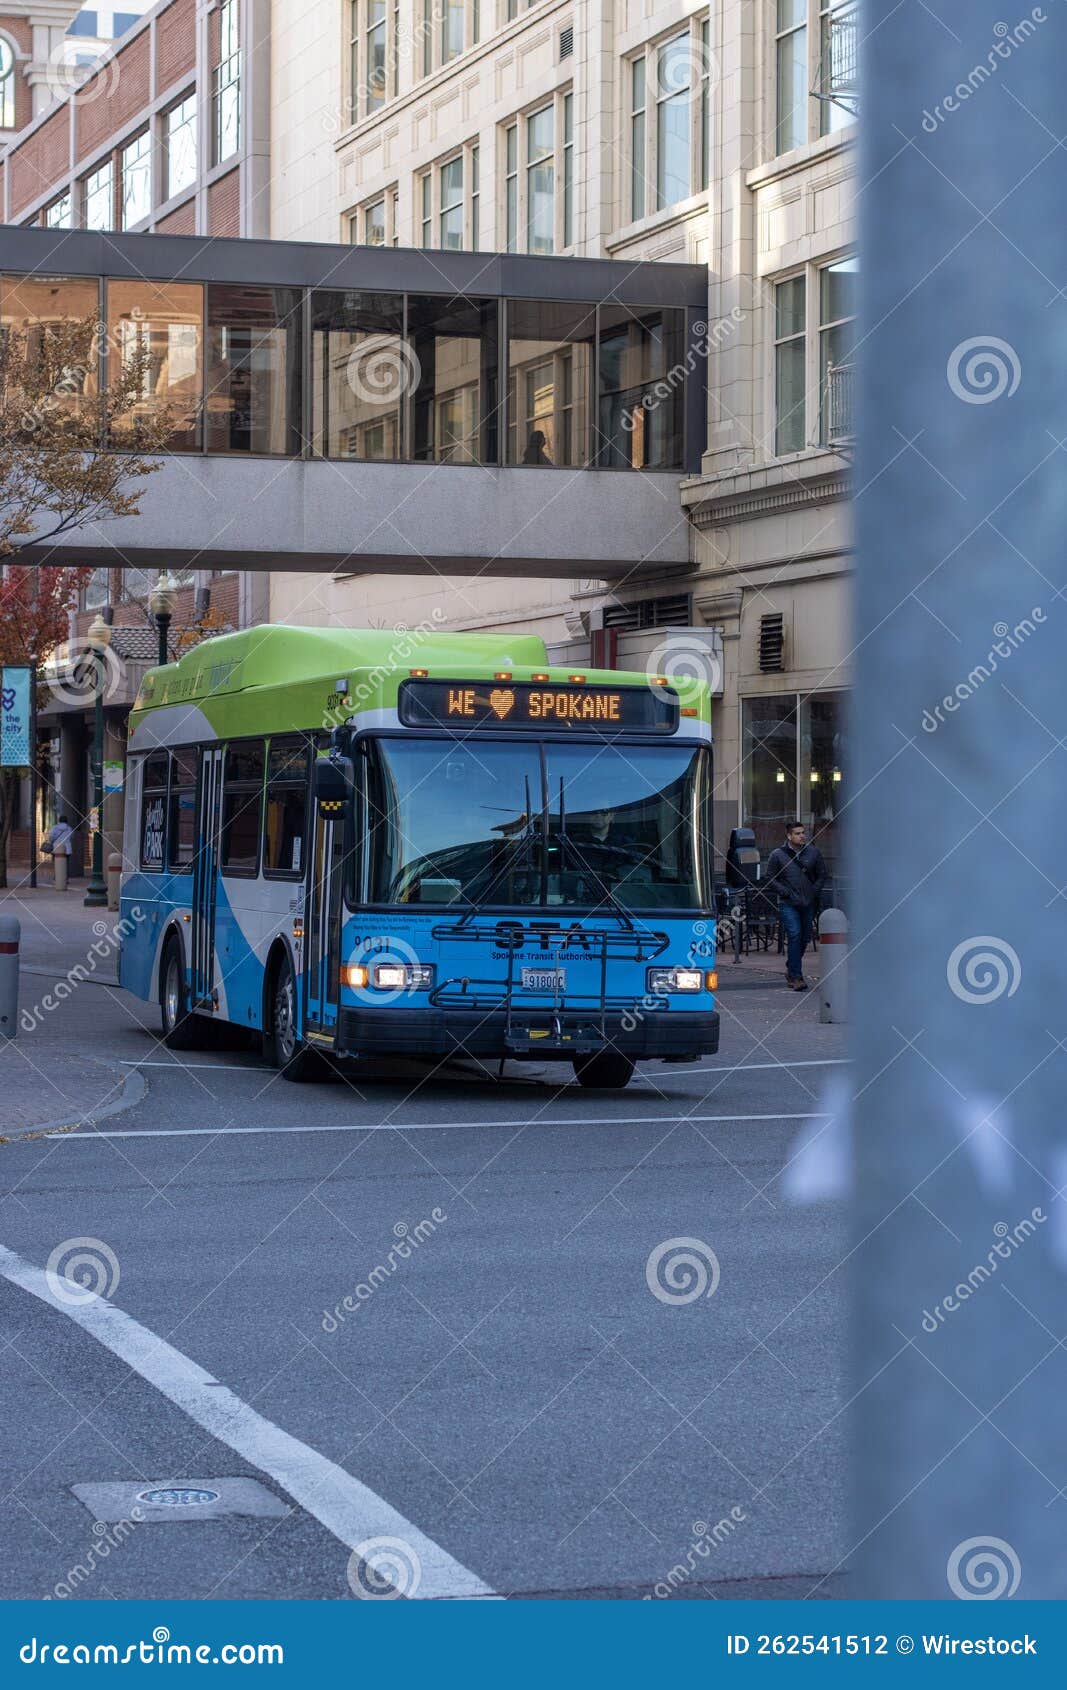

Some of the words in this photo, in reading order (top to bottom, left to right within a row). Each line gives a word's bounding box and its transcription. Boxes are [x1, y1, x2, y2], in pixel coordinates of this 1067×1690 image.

[449, 690, 476, 715] WE
[529, 692, 620, 719] SPOKANE
[5, 714, 20, 722] the
[5, 723, 22, 733] city
[495, 921, 591, 950] STA
[354, 935, 390, 953] 9031
[527, 952, 554, 960] Transit
